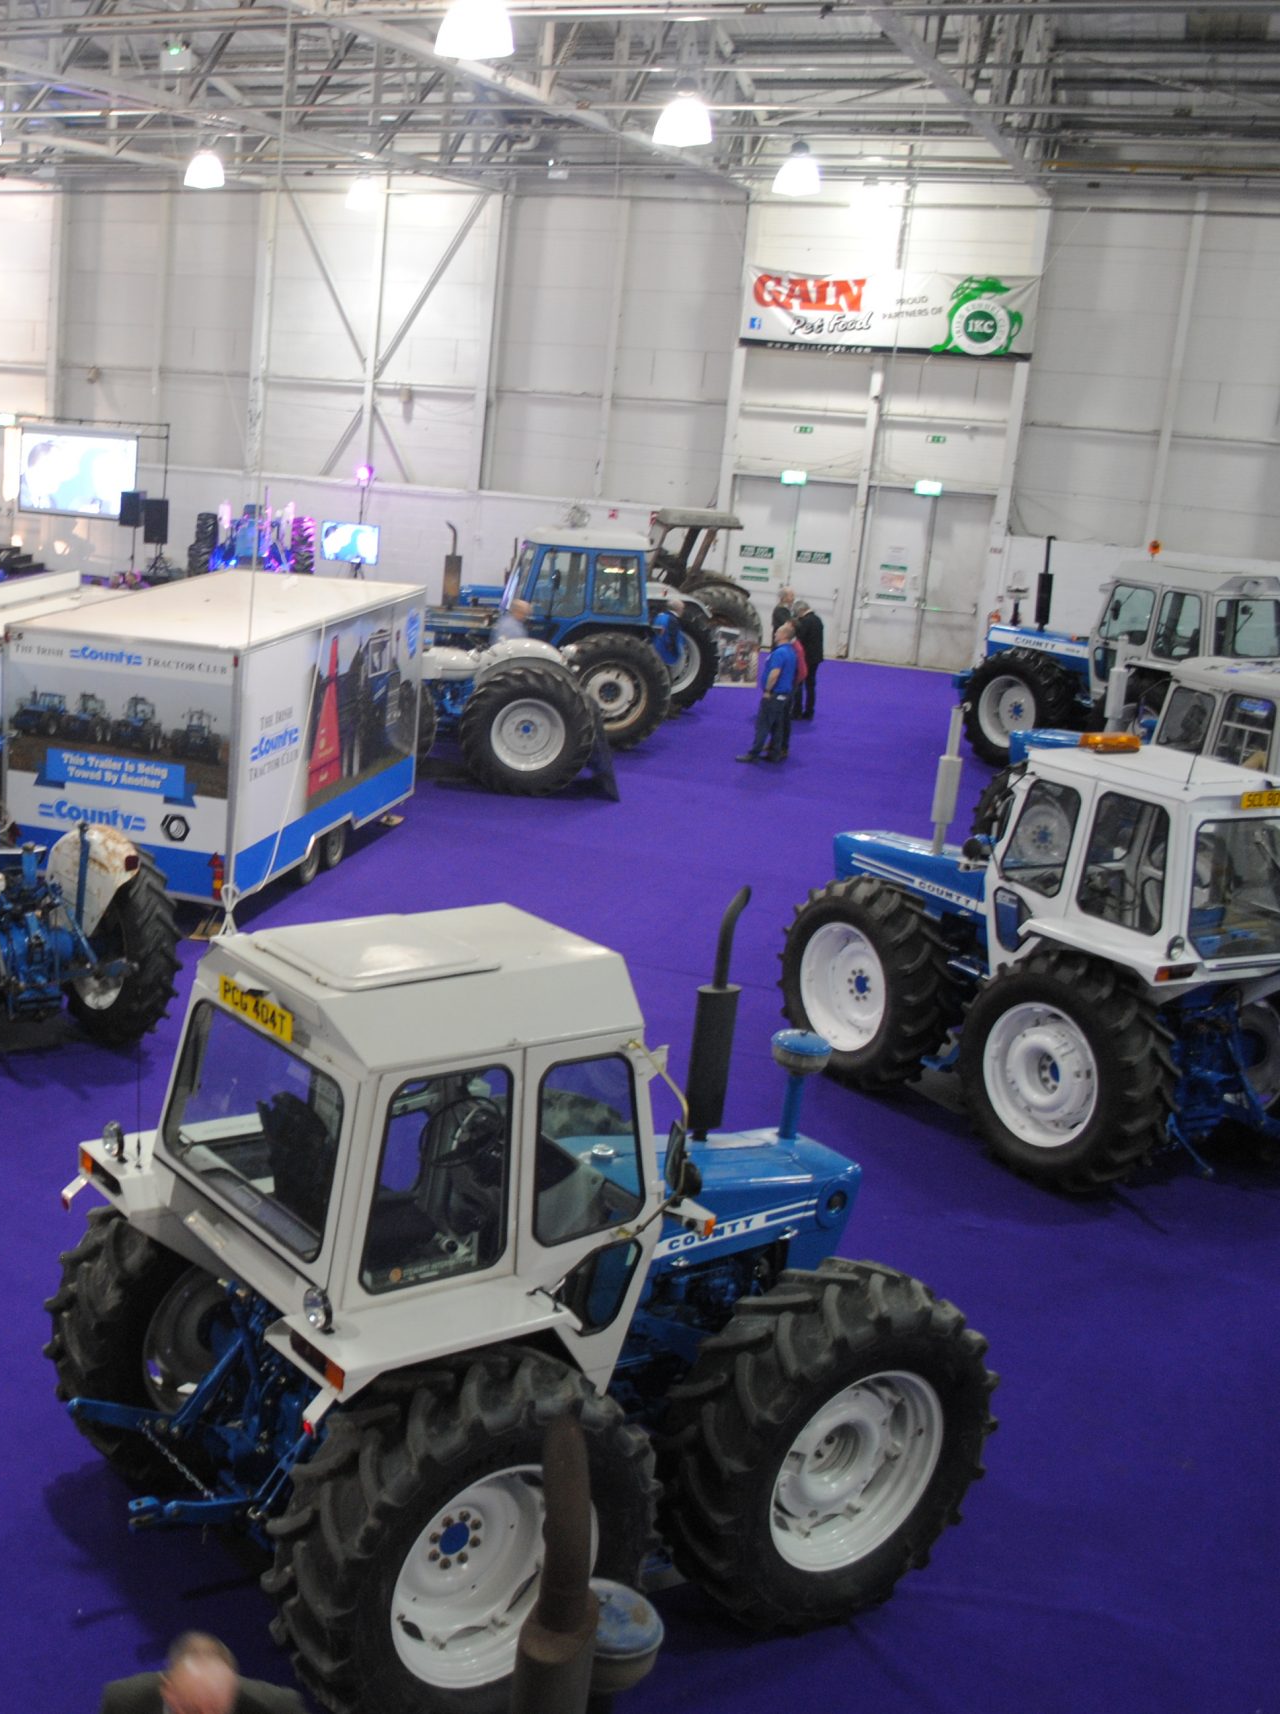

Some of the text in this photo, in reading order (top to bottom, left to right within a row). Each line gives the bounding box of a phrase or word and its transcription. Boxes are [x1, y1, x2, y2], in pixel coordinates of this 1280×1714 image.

[753, 274, 867, 312] GAIN
[788, 311, 874, 335] Pet Food
[967, 319, 995, 333] IKC
[1014, 636, 1057, 650] COUNTY
[80, 645, 133, 665] County
[145, 656, 195, 671] TRACTOR
[198, 662, 227, 675] CLUB
[259, 728, 293, 757] County
[62, 752, 86, 767] This
[87, 756, 123, 770] Trailer
[137, 762, 169, 779] Being
[67, 766, 163, 789] Towed By Another
[54, 800, 133, 831] County
[918, 880, 971, 907] COUNTY
[223, 980, 286, 1035] PCG 404T
